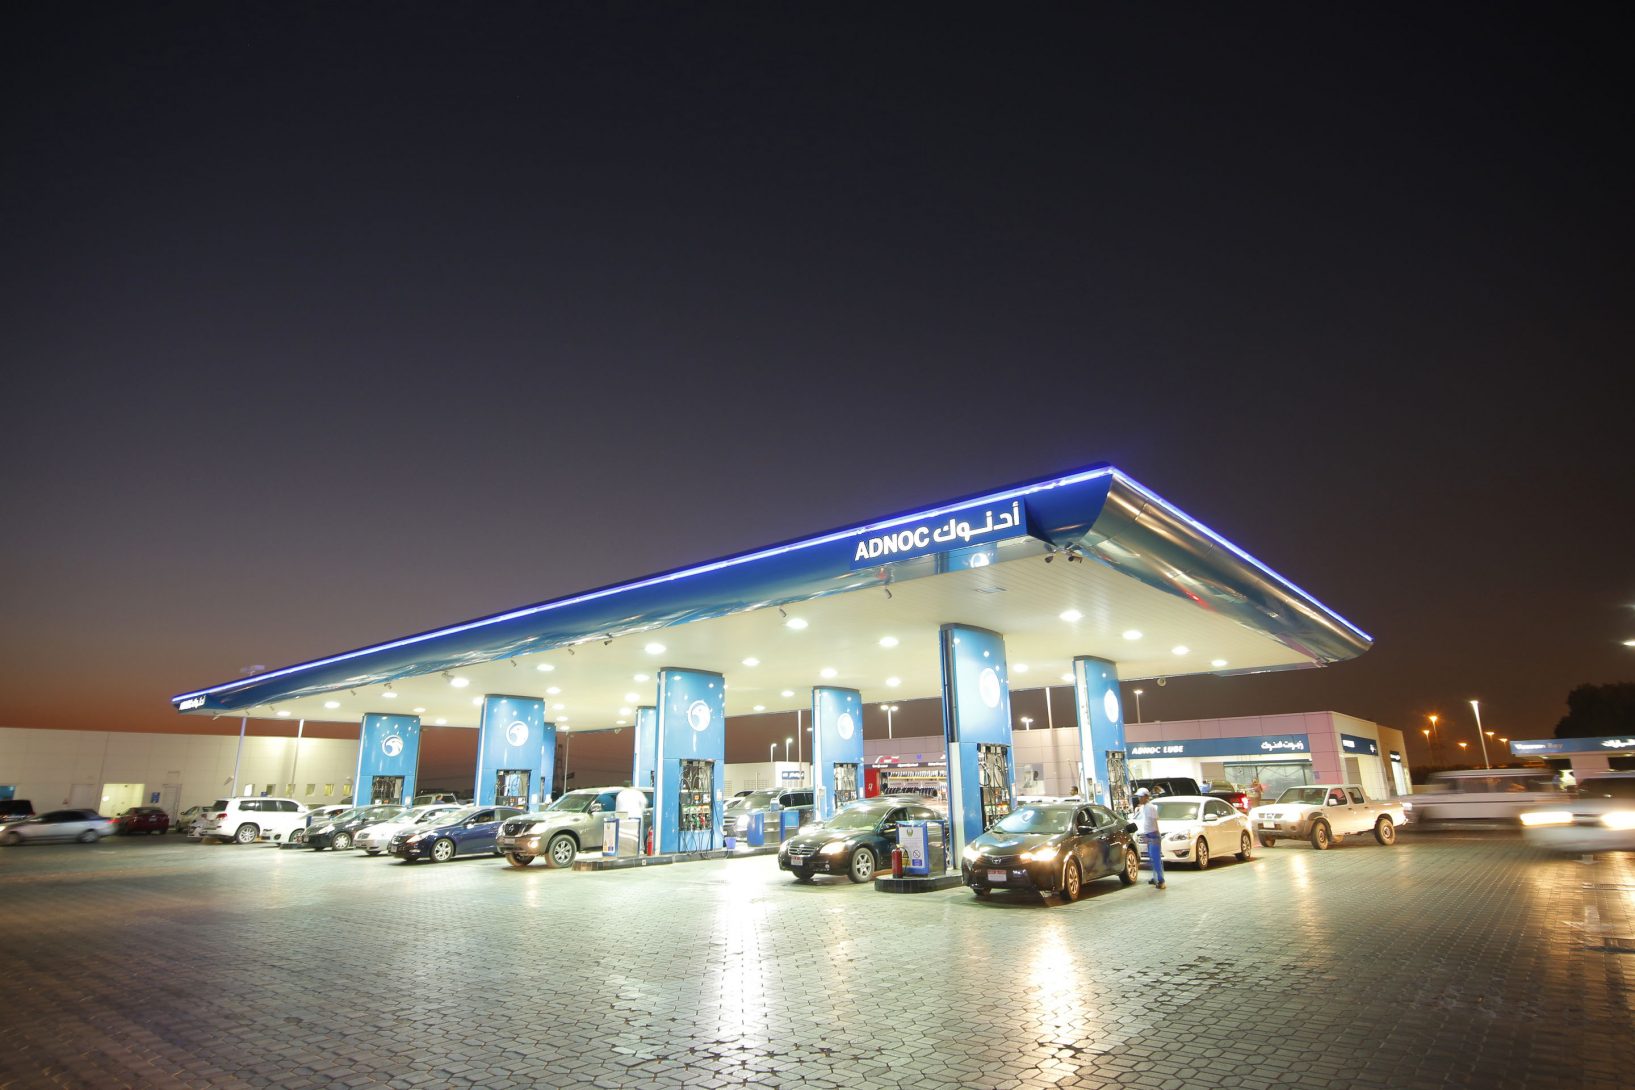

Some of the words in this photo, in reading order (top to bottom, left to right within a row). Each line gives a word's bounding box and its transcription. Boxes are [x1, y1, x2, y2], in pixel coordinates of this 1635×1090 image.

[933, 501, 1020, 542] أدنوك
[854, 527, 930, 561] ADNOC
[1131, 746, 1161, 755] ADNOC
